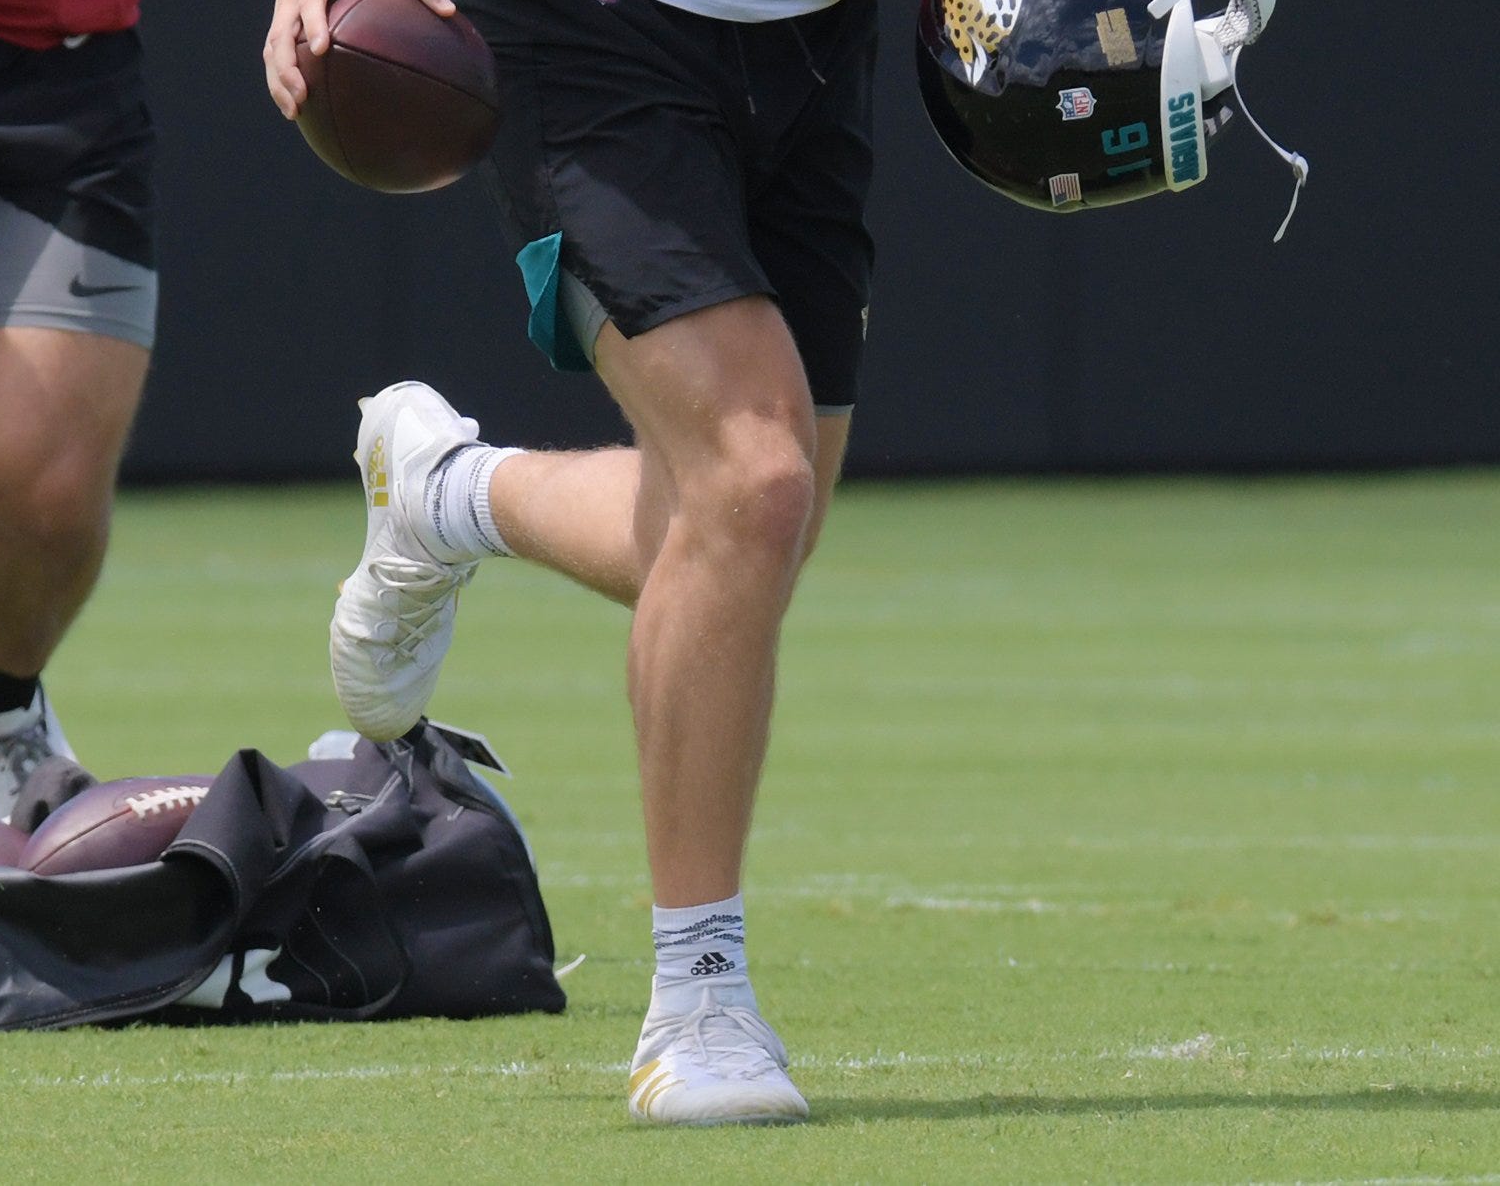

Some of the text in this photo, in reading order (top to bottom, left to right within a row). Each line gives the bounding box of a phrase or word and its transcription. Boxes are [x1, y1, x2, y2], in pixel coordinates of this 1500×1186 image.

[1073, 91, 1090, 114] NFL
[1101, 121, 1153, 177] 16
[690, 960, 736, 976] adidas
